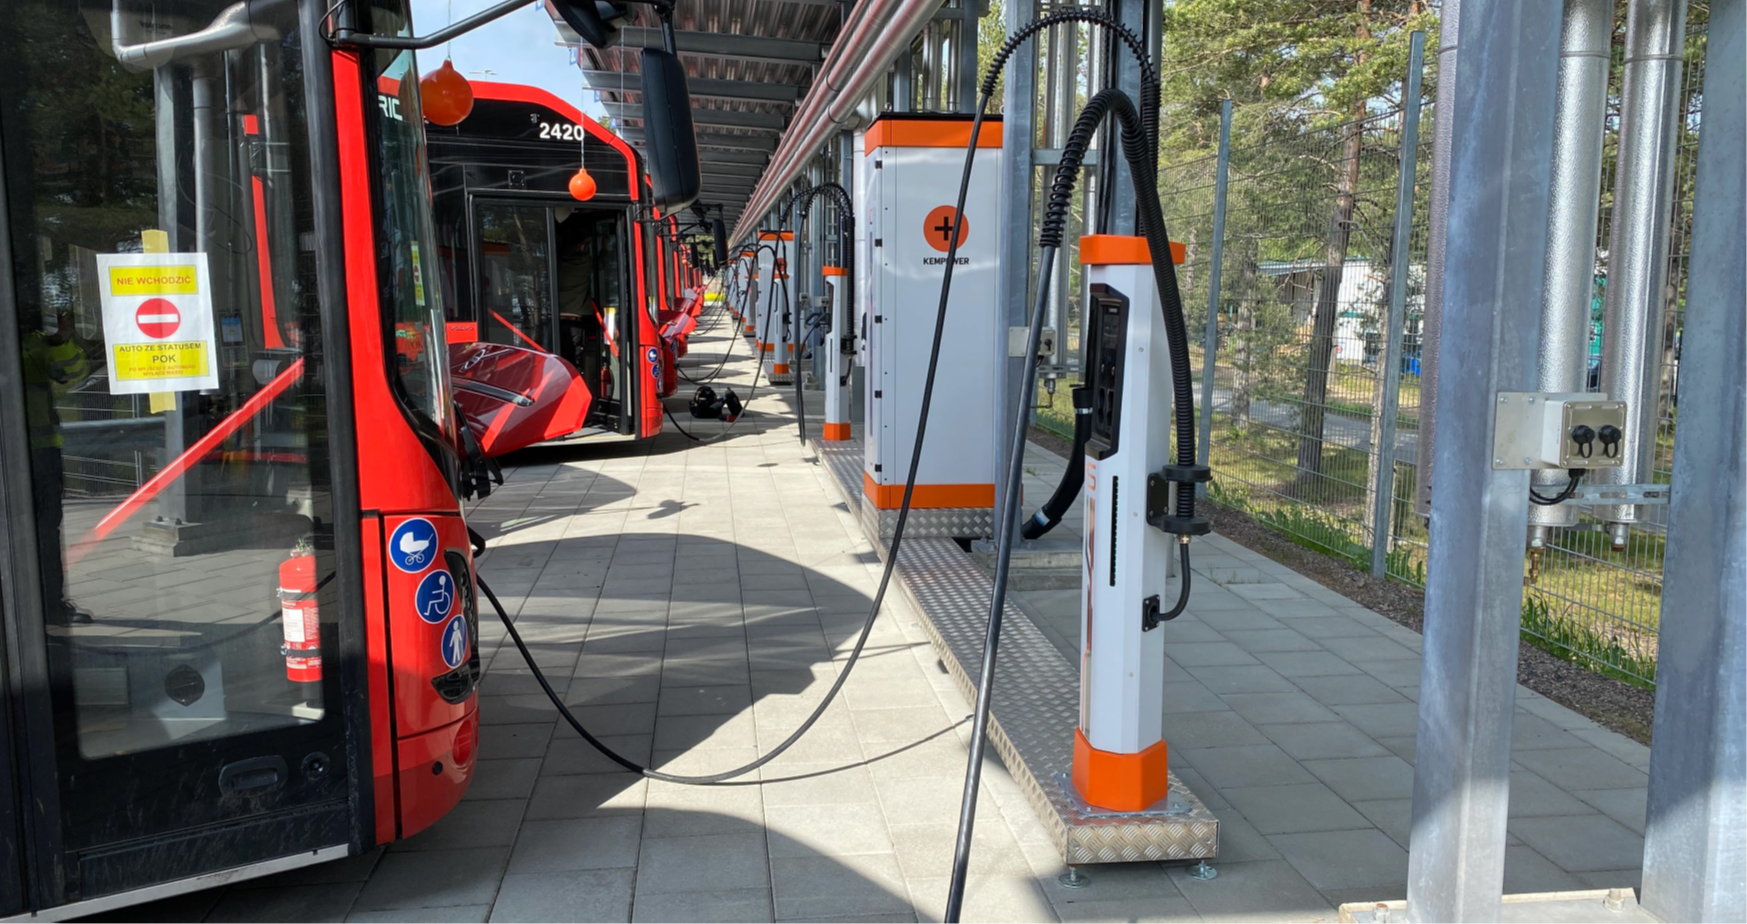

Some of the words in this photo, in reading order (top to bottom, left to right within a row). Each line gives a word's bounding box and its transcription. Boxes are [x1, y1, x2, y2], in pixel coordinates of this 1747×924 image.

[539, 122, 585, 141] 2420
[923, 257, 969, 265] KEMPWER
[116, 277, 133, 285] NIE
[136, 275, 191, 284] WCHODZIĆ
[119, 345, 143, 353] AUTO
[145, 344, 155, 352] ZE
[157, 343, 201, 351] STATUSEM
[152, 355, 176, 363] POK
